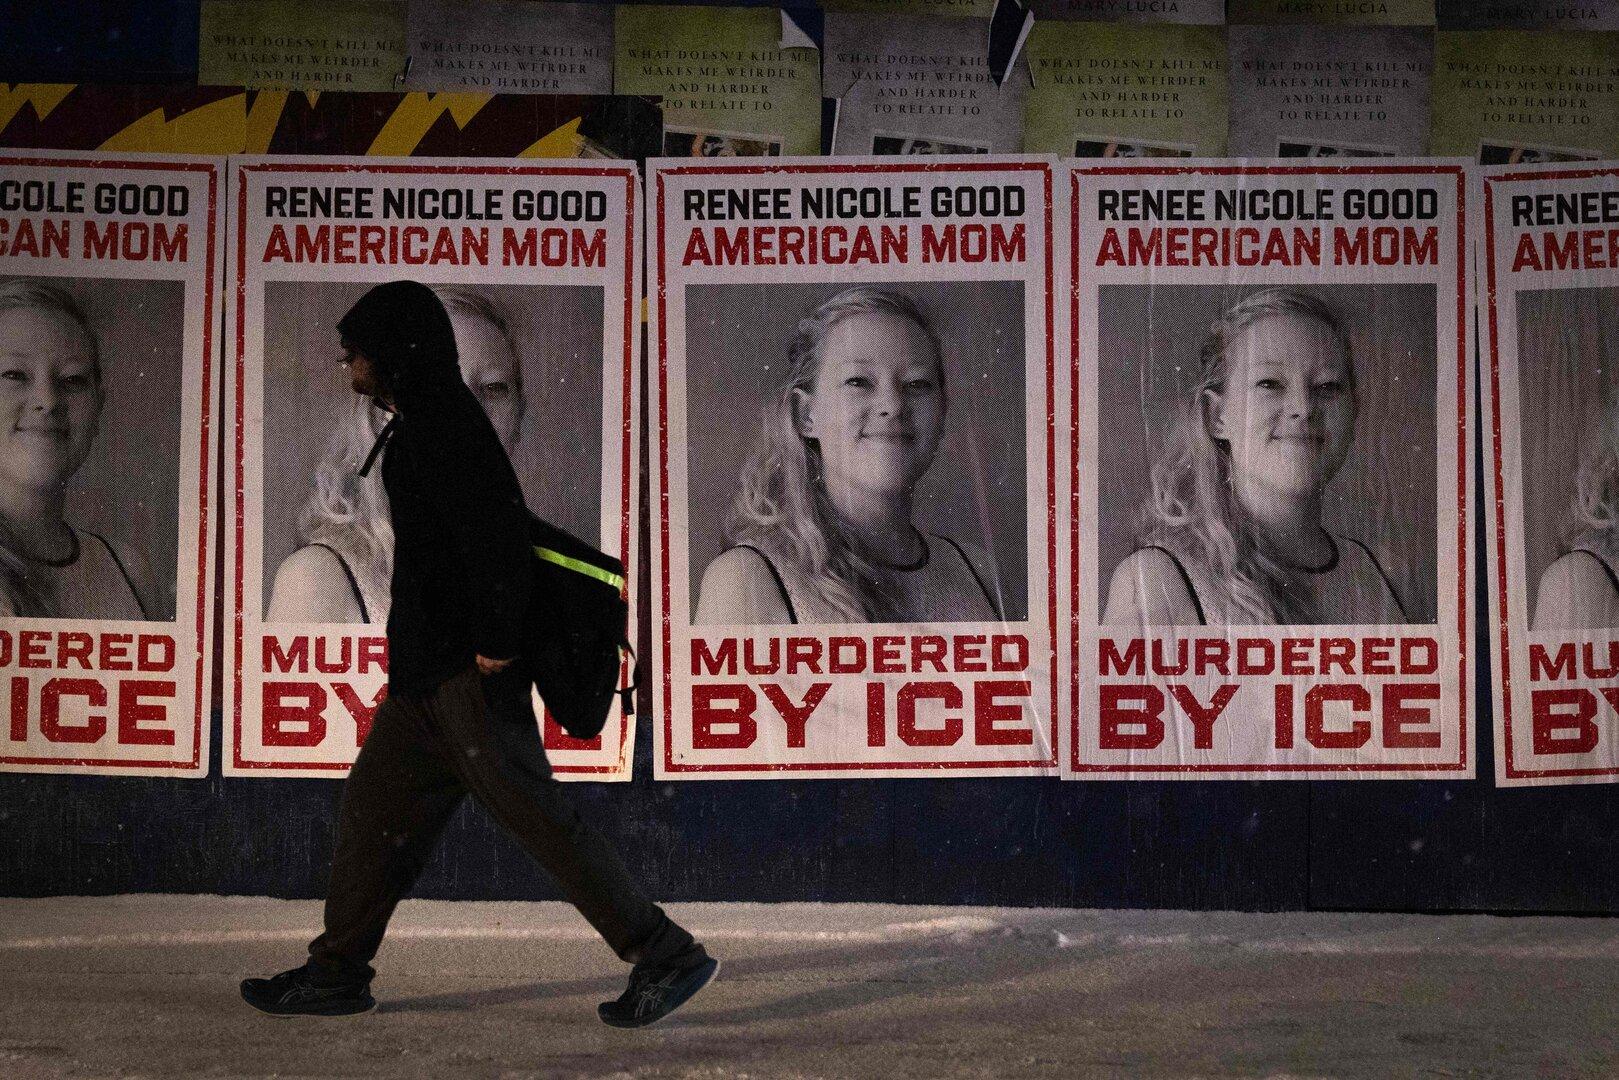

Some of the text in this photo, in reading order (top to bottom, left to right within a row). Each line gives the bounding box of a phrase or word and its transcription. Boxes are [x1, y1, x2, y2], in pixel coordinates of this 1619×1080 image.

[1126, 1, 1179, 13] LUCIA
[1335, 3, 1388, 14] LUCIA
[1545, 8, 1598, 19] LUCIA
[212, 35, 398, 51] WHAT DOESN'T KILL ME
[420, 41, 602, 58] WHAT DOESN'T KILL ME
[226, 52, 380, 68] MAKES ME WEIRDER
[627, 49, 810, 62] WHAT DOESN'T KILL ME
[836, 53, 880, 64] WHAT
[887, 54, 951, 65] DOESN'T
[433, 58, 587, 74] MAKES ME WEIRDER
[1038, 58, 1221, 70] WHAT DOESN'T KILL ME
[1242, 60, 1425, 72] WHAT DOESN'T KILL ME
[1446, 62, 1488, 73] WHAT
[1496, 63, 1562, 75] DOESN'T
[1570, 66, 1603, 76] KILL
[253, 70, 353, 83] AND HARDER
[642, 65, 796, 79] MAKES ME WEIRDER
[851, 70, 993, 83] MAKES ME WEIRDE
[459, 76, 560, 89] AND HARDER
[1053, 74, 1207, 87] MAKES ME WEIRDER
[1256, 77, 1411, 89] MAKES ME WEIRDER
[1461, 79, 1615, 93] MAKES ME WEIRDER
[668, 82, 769, 94] AND HARDER
[878, 88, 977, 99] AND HARDER
[1081, 92, 1180, 102] AND HARDER
[1282, 94, 1383, 104] AND HARDER
[1486, 97, 1588, 108] AND HARDER
[665, 99, 773, 111] TO RELATE TO
[873, 104, 981, 115] TO RELATE TO
[1075, 108, 1184, 119] TO RELATE TO
[1278, 110, 1387, 121] TO RELATE TO
[1483, 112, 1591, 125] TO RELATE TO
[0, 180, 189, 216] COLE GOOD
[266, 187, 606, 221] RENEE NICOLE GOOD
[684, 186, 1025, 220] RENEE NICOLE GOOD
[1099, 189, 1437, 220] RENEE NICOLE GOOD
[1512, 192, 1619, 226] RENEE
[84, 221, 187, 261] MOM
[263, 224, 606, 267] AMERICAN MOM
[683, 224, 1025, 265] AMERICAN MOM
[1096, 227, 1438, 266] AMERICAN MOM
[691, 635, 1029, 675] MURDERED
[1099, 638, 1438, 676] MURDERED
[10, 677, 175, 745] ICE
[262, 682, 389, 747] BY
[692, 681, 1033, 749] BY ICE
[1100, 684, 1441, 749] BY ICE
